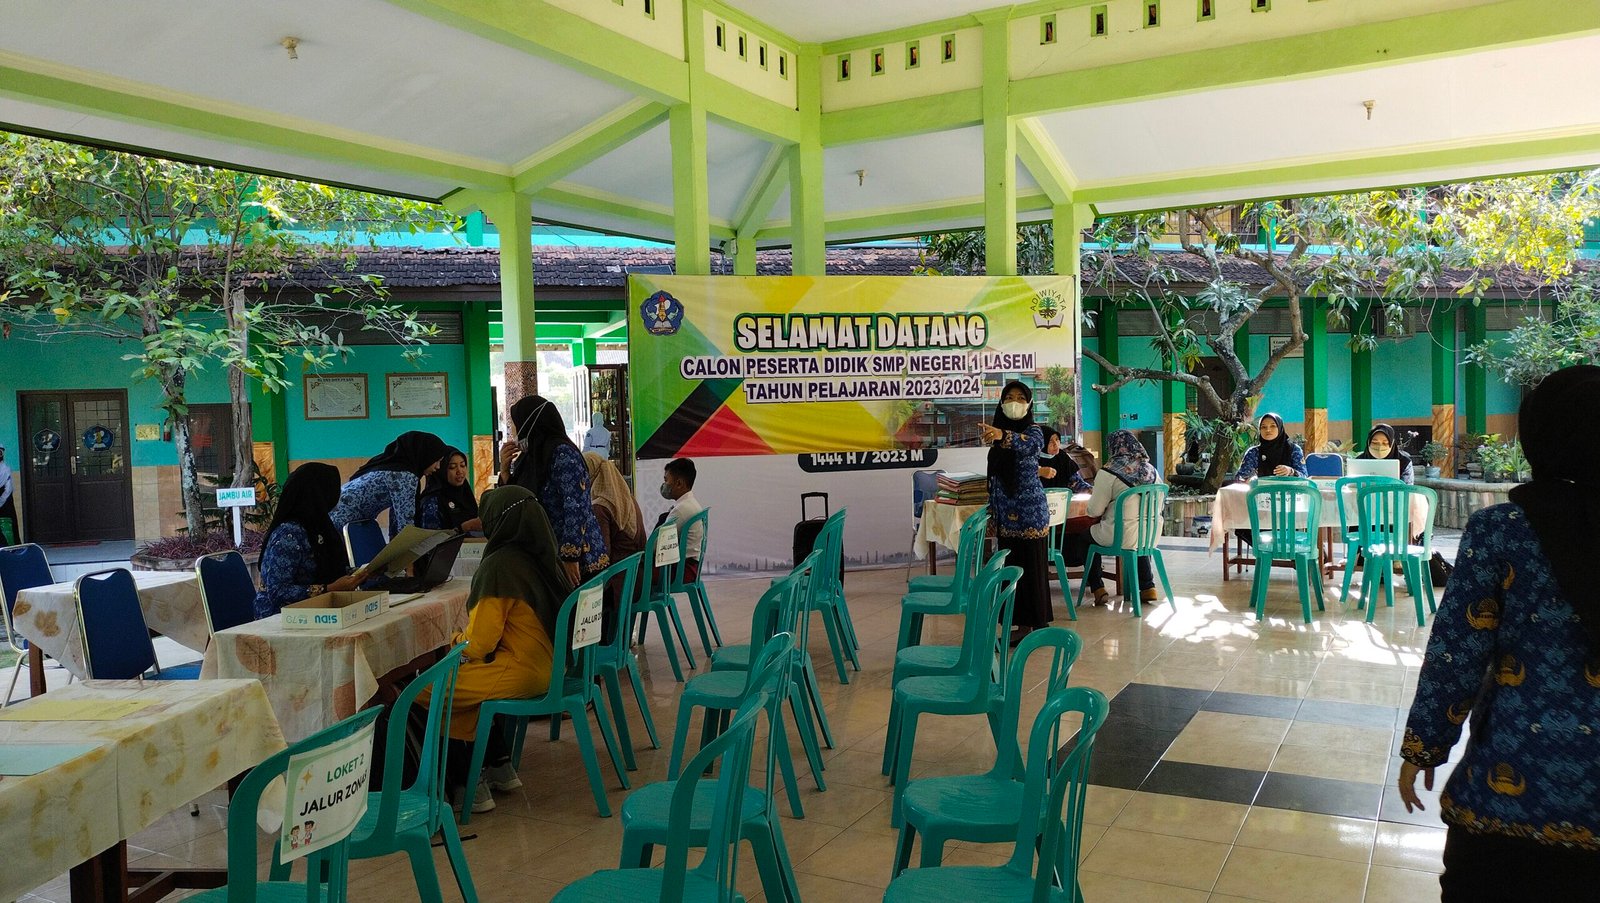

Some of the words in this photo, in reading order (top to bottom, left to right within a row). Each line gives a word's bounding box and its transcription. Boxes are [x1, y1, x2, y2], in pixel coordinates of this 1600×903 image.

[1030, 288, 1067, 312] ADIWIYATA
[736, 313, 873, 351] SELAMAT
[876, 313, 988, 349] DATANG
[683, 357, 741, 376] CALON
[746, 356, 819, 375] PESERTA
[823, 355, 868, 374] DIDIK
[872, 354, 906, 373] SMP
[909, 354, 966, 372] NEGERI
[970, 353, 980, 371] 1
[984, 353, 1034, 371] LASEM
[747, 382, 804, 401] TAHUN
[808, 380, 901, 399] PELAJARAN
[905, 377, 981, 397] 2023/2024
[810, 452, 843, 466] 1444
[846, 451, 857, 465] H
[872, 449, 907, 464] 2023
[910, 448, 924, 462] M
[218, 490, 240, 501] JAMBU
[241, 489, 253, 499] AIR
[326, 756, 360, 783] LOKET
[359, 753, 365, 766] 2
[299, 789, 344, 817] JALUR
